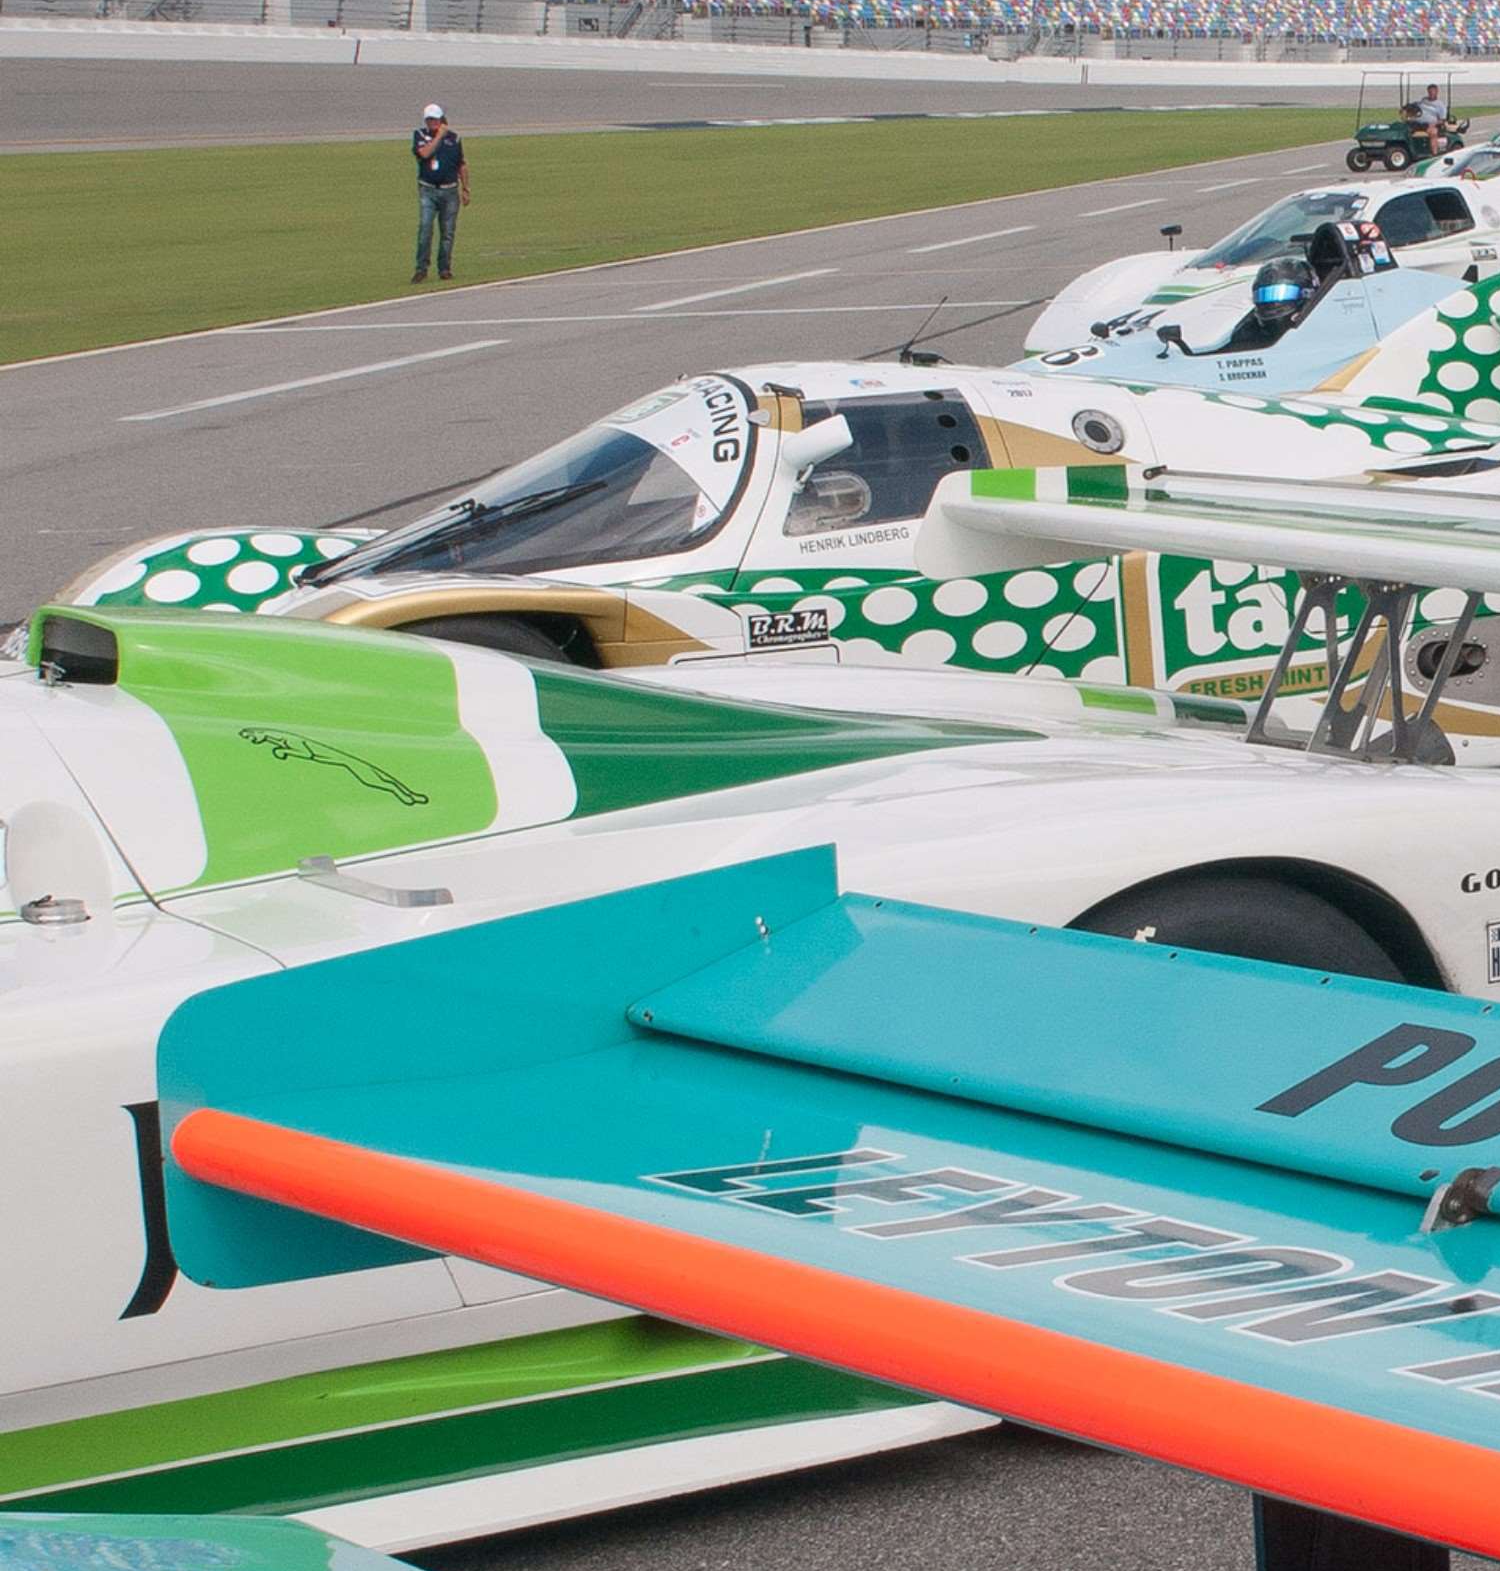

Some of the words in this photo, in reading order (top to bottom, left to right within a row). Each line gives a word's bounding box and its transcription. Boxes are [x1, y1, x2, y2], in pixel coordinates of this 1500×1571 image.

[1226, 357, 1264, 368] PAPPAS
[694, 377, 740, 463] RACING
[800, 537, 846, 554] HENRIK
[849, 527, 910, 547] LINDBERG
[1190, 675, 1263, 696] FRESH
